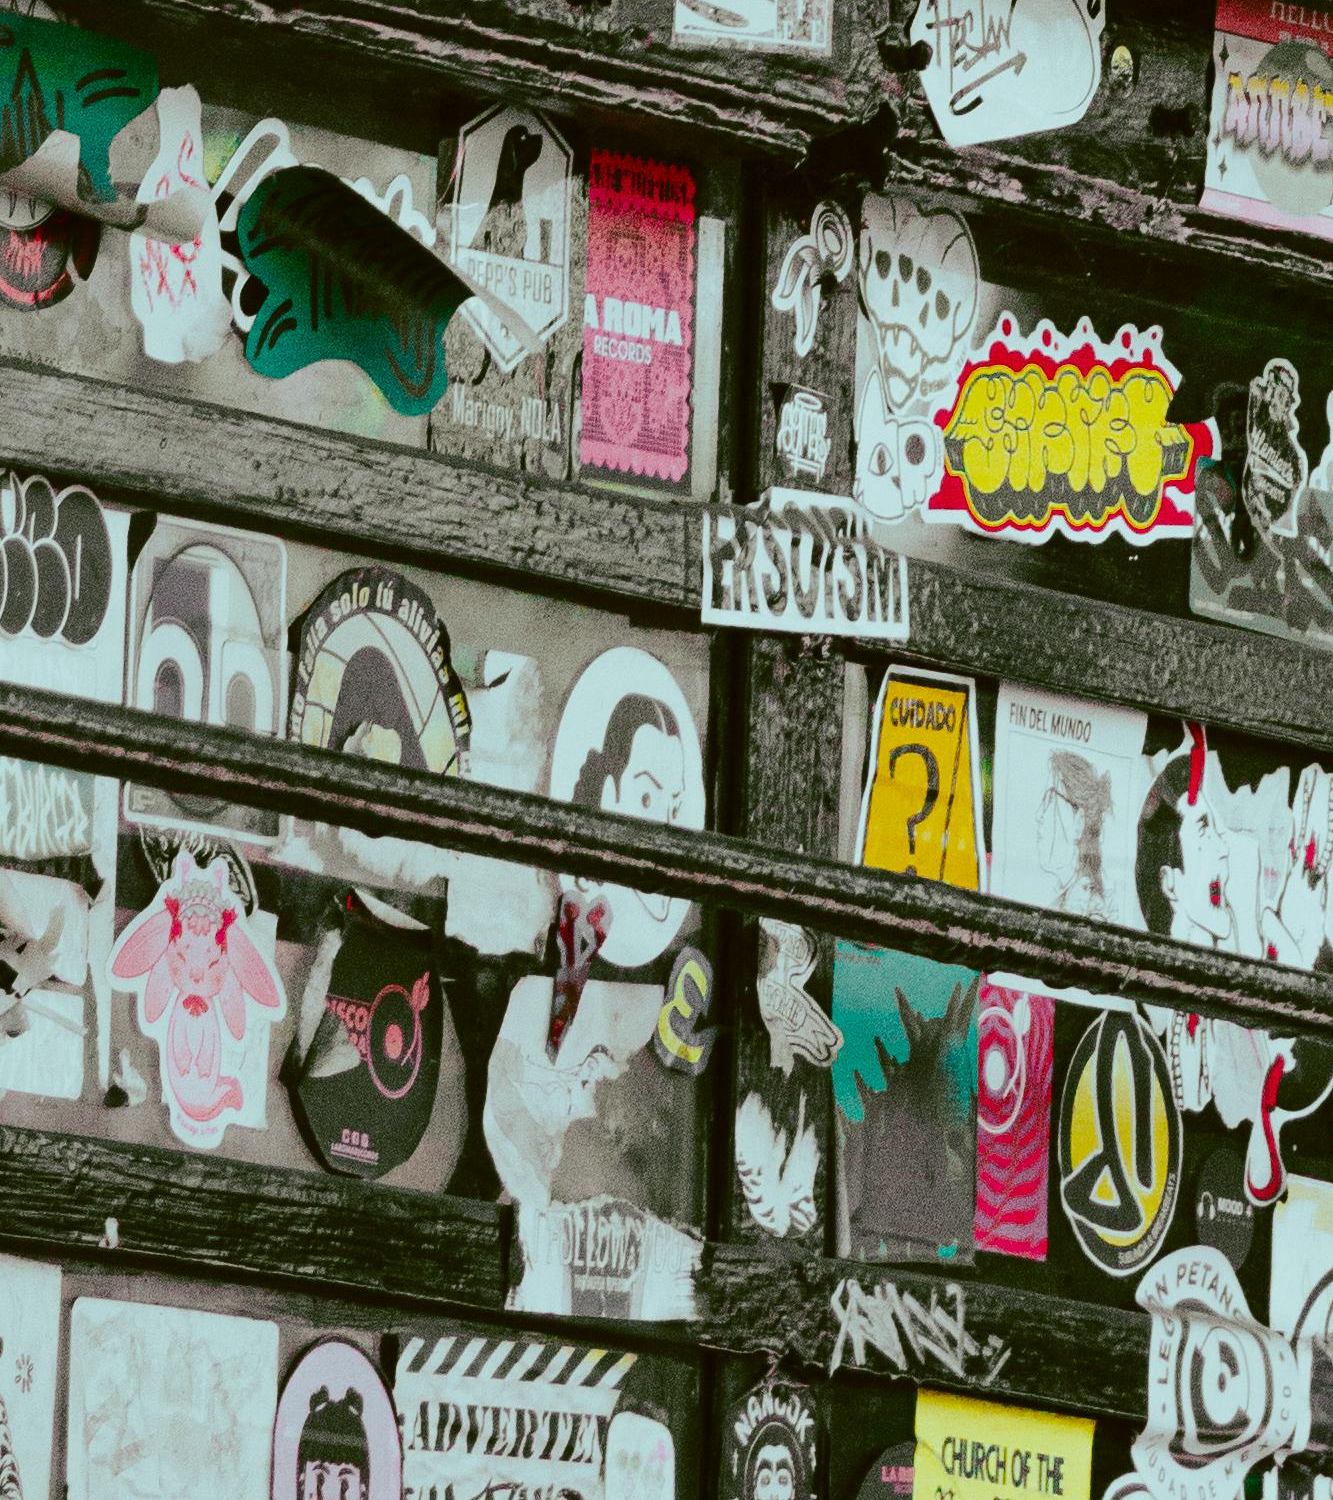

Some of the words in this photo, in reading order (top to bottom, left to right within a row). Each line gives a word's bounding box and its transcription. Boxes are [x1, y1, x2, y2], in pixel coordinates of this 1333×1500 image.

[523, 271, 552, 304] PUB
[603, 296, 683, 347] ROMA
[593, 334, 653, 366] RECORDS
[520, 396, 562, 443] NOLA
[329, 581, 370, 623] solo
[888, 695, 957, 733] CUIDADO
[1009, 701, 1029, 727] FIN
[1029, 707, 1053, 732] DEL
[1054, 712, 1092, 744] MUNDO
[941, 1437, 1008, 1480] CHURCH
[1010, 1449, 1033, 1484] OF
[1034, 1455, 1065, 1495] THE
